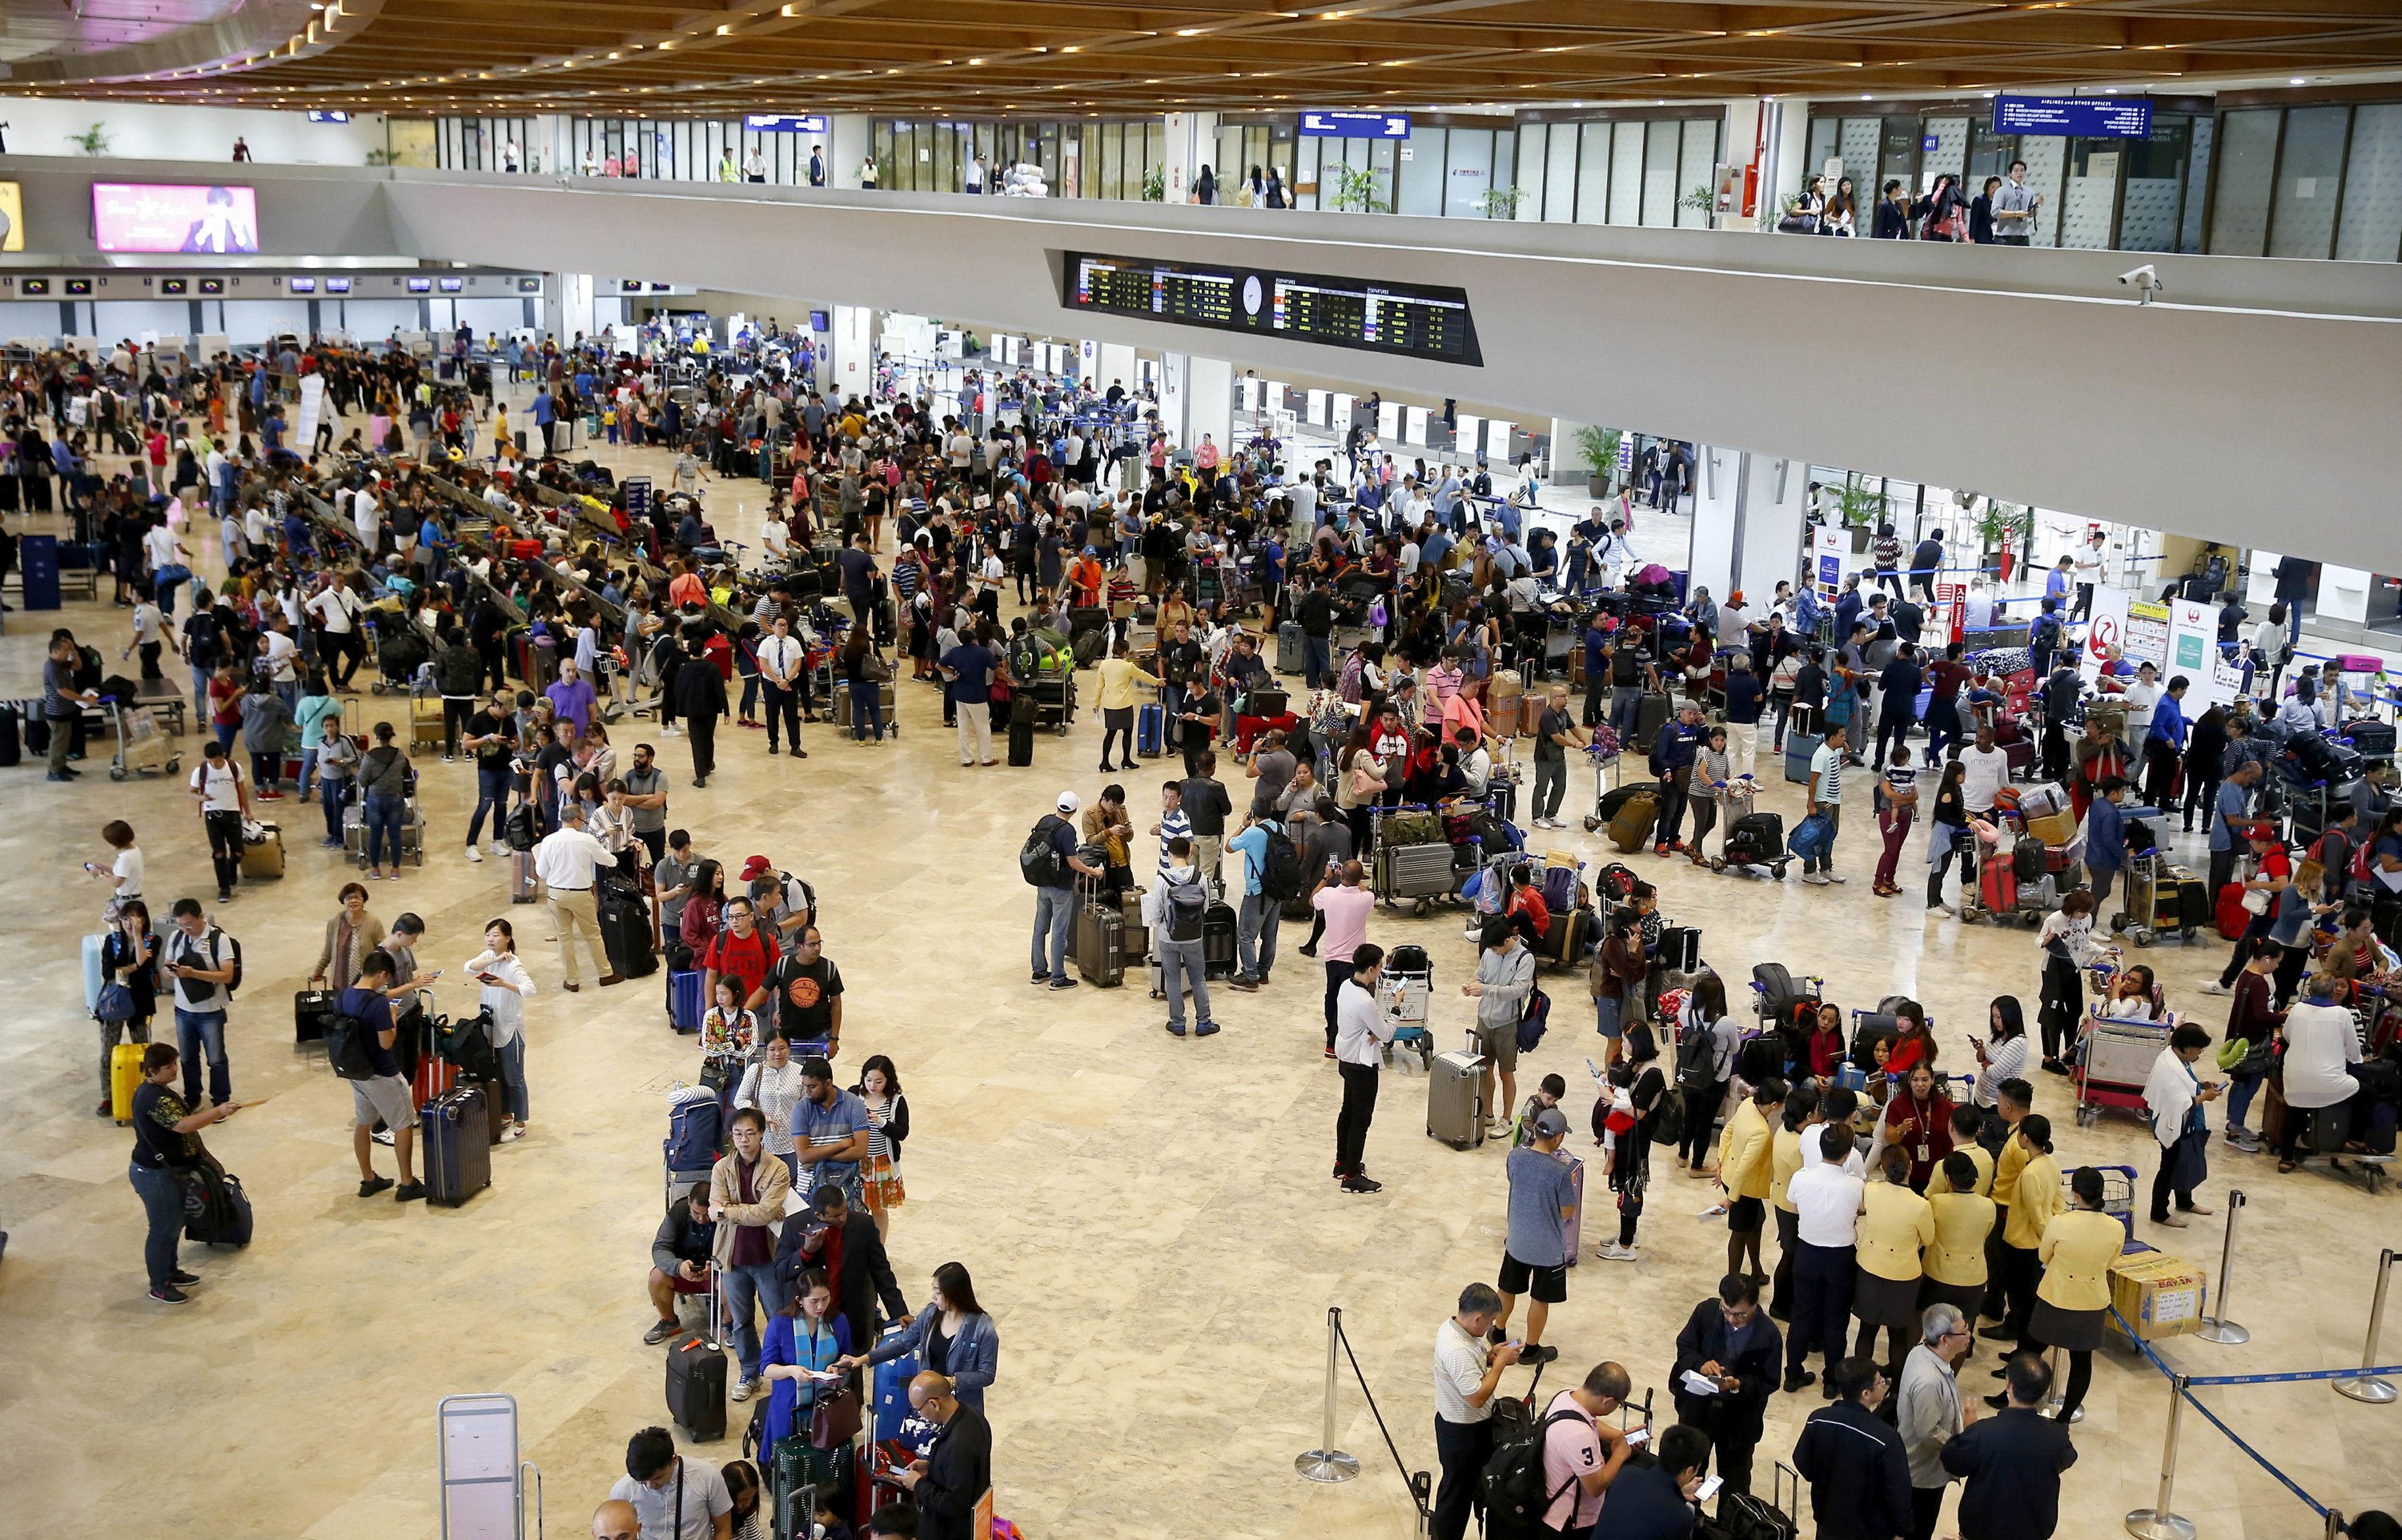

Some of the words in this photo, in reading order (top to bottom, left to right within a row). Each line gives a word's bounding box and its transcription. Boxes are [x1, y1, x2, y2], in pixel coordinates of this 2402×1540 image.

[1925, 139, 1935, 148] 411
[1956, 588, 1965, 603] 入口
[1954, 604, 1962, 628] ENTRANCE
[1970, 758, 1998, 766] ICONIC
[1582, 1447, 1593, 1466] 3
